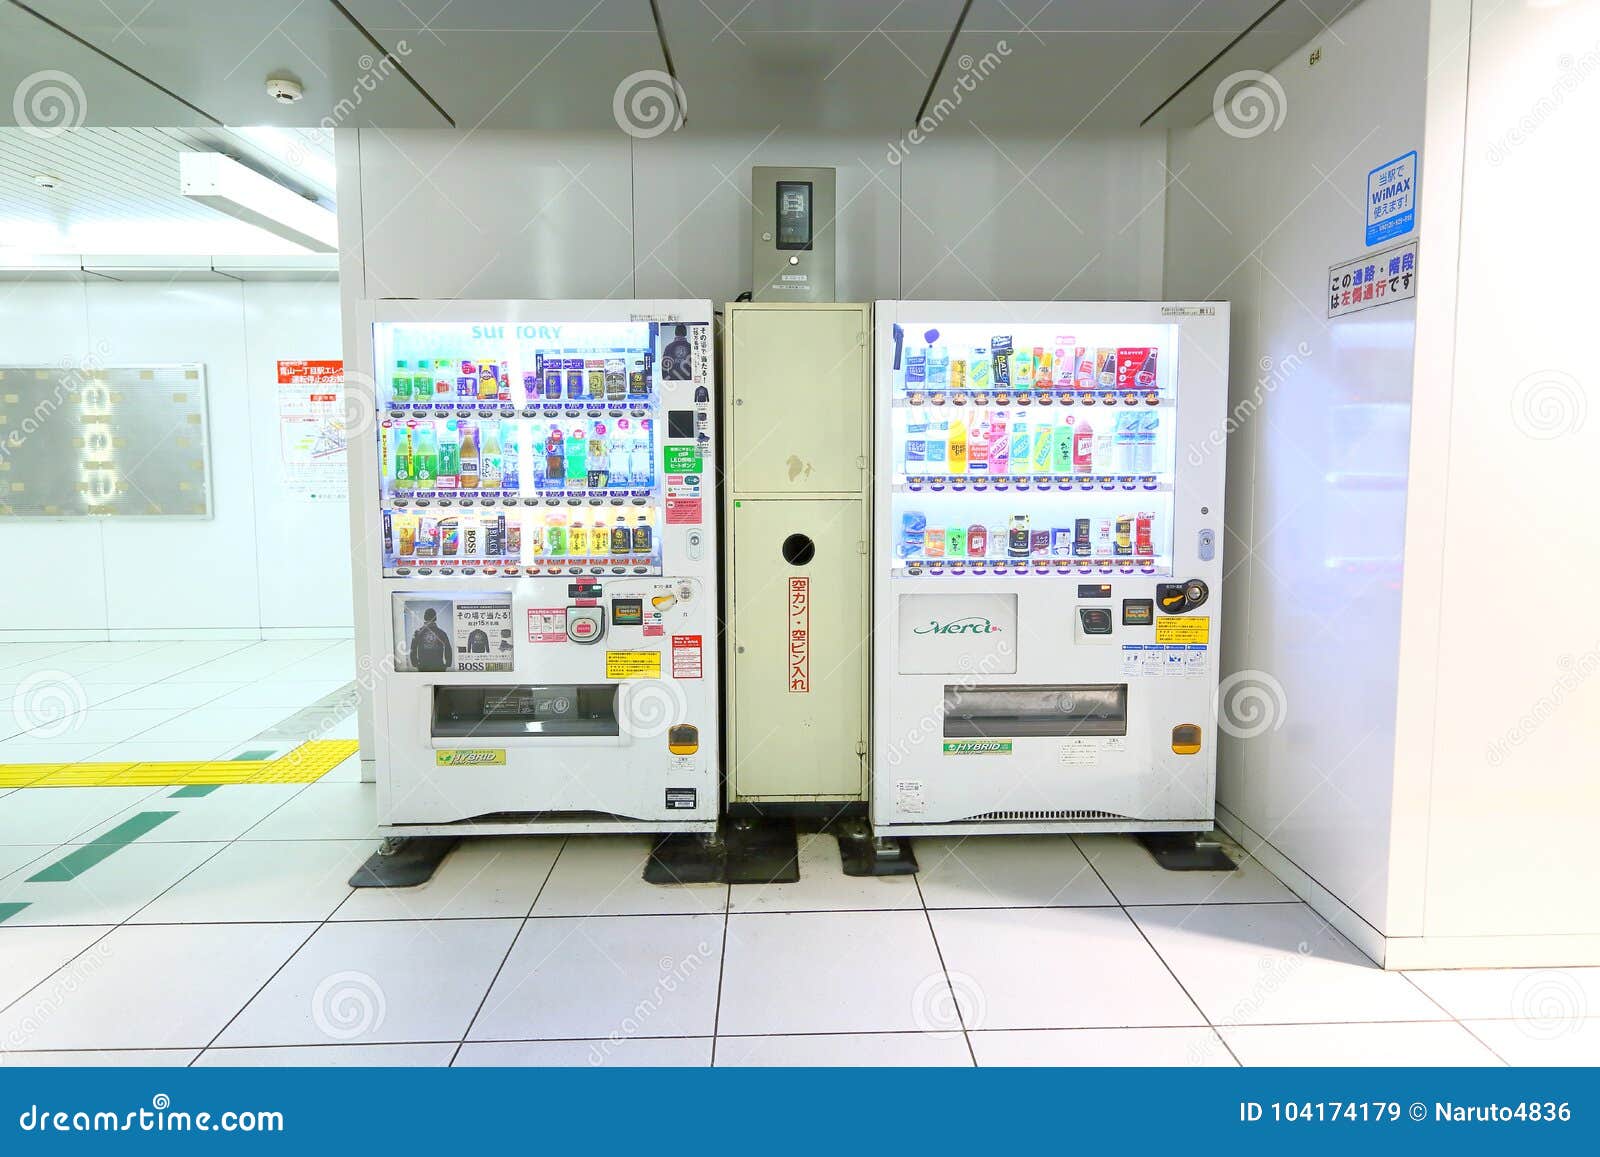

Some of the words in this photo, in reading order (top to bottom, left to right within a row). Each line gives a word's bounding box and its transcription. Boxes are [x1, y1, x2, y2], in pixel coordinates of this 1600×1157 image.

[1309, 48, 1321, 66] 64
[1372, 178, 1411, 205] WiMAX
[467, 530, 477, 554] BOSS
[791, 579, 807, 691] 空カン・空ビン入れ
[913, 616, 991, 635] Merci
[458, 662, 485, 672] BOSS
[956, 743, 1001, 753] HYBRID
